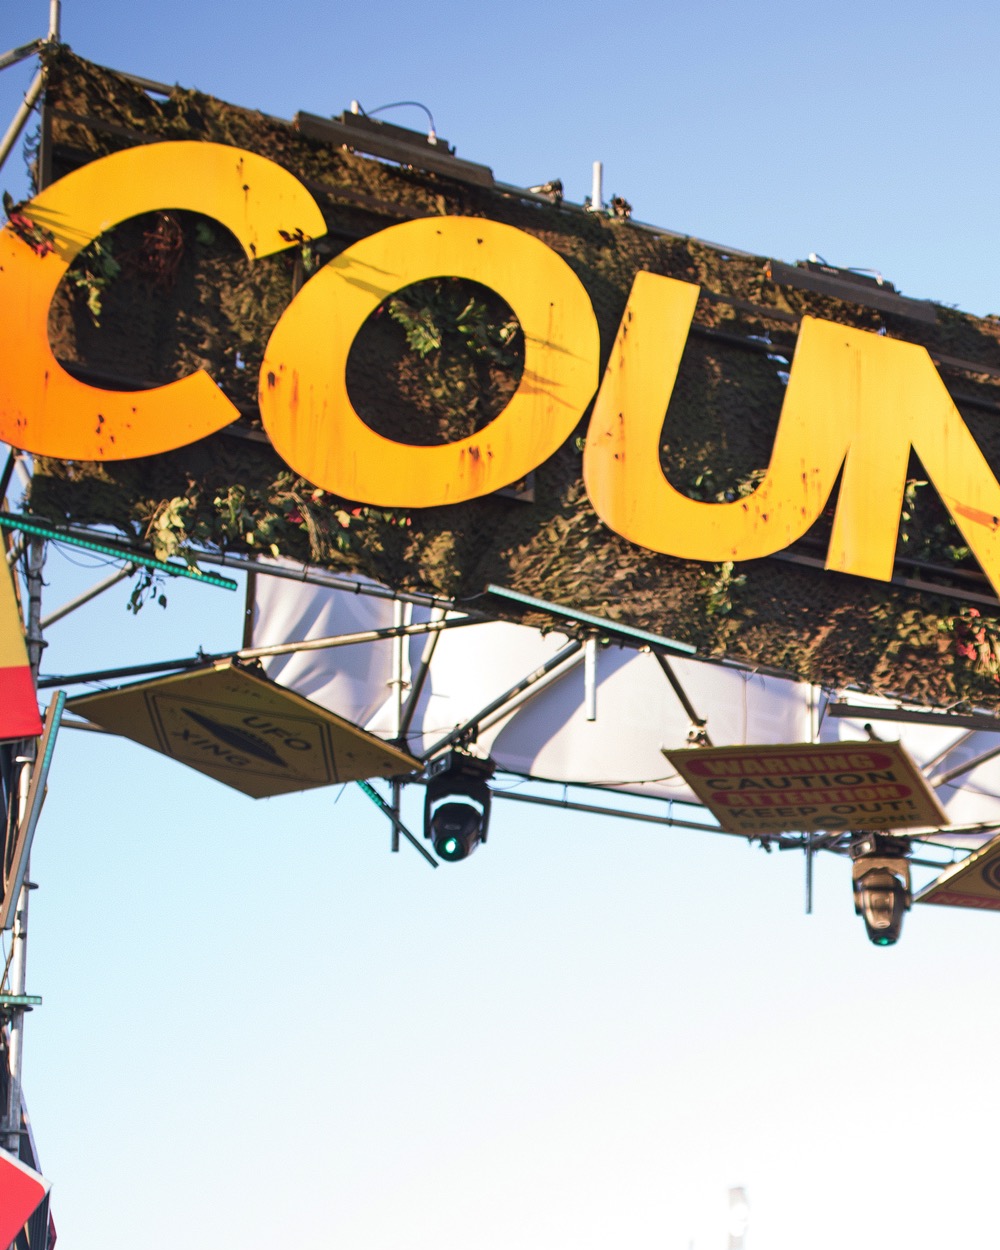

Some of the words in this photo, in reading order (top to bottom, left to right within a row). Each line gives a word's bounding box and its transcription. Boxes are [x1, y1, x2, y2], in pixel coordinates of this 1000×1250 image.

[242, 715, 312, 751] UFO
[172, 728, 250, 767] XING
[703, 752, 875, 775] WARNING
[706, 771, 897, 791] CAUTION
[725, 786, 900, 805] ATTENTION
[728, 806, 818, 819] KEEP
[832, 800, 918, 814] OUT!
[852, 813, 924, 825] ZONE
